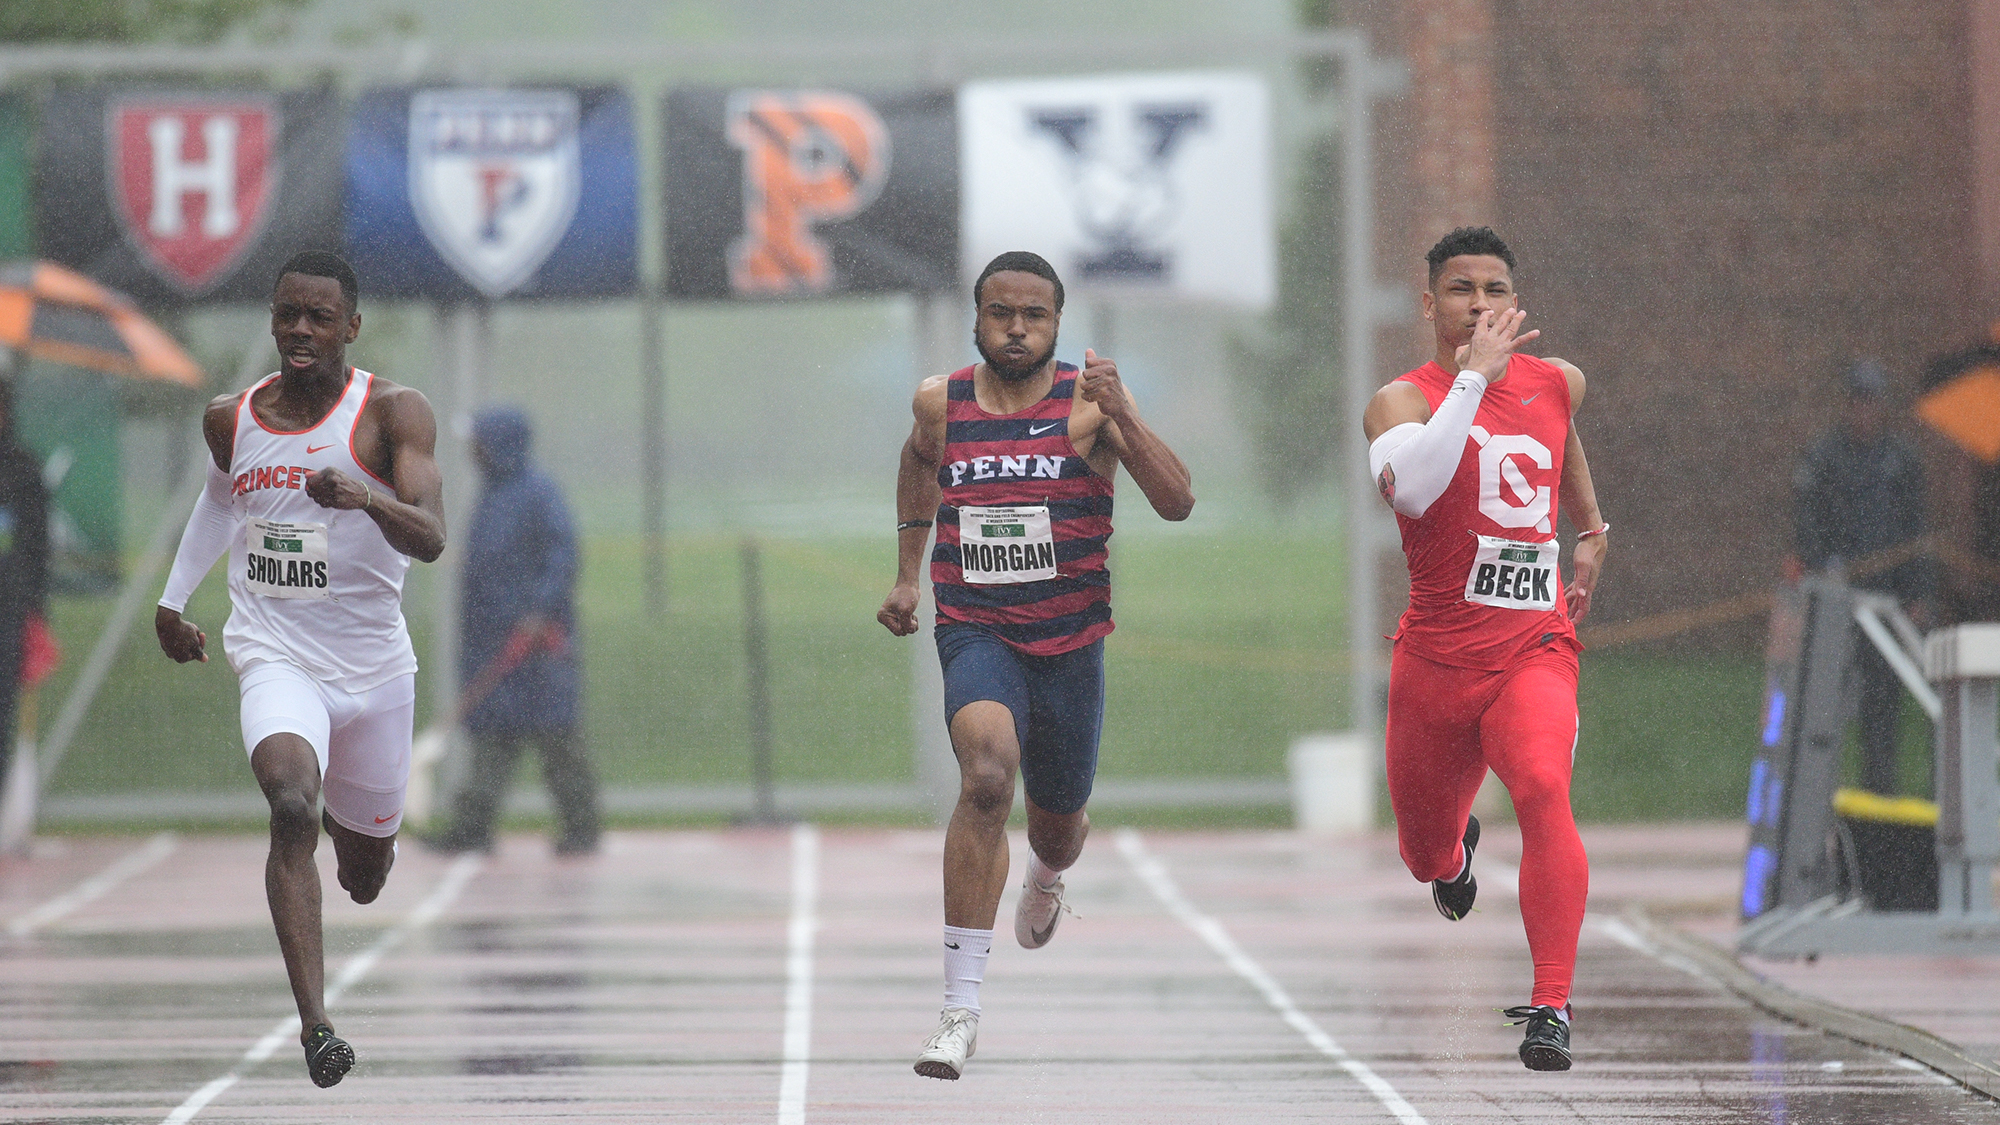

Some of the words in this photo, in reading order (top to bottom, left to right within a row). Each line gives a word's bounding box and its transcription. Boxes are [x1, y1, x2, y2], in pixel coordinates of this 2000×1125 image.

[147, 115, 239, 239] H
[727, 92, 891, 291] P
[949, 454, 1066, 487] PENN
[1478, 434, 1553, 528] C
[247, 552, 328, 589] SHOLARS
[962, 542, 1054, 573] MORGAN
[1473, 563, 1551, 602] BECK
